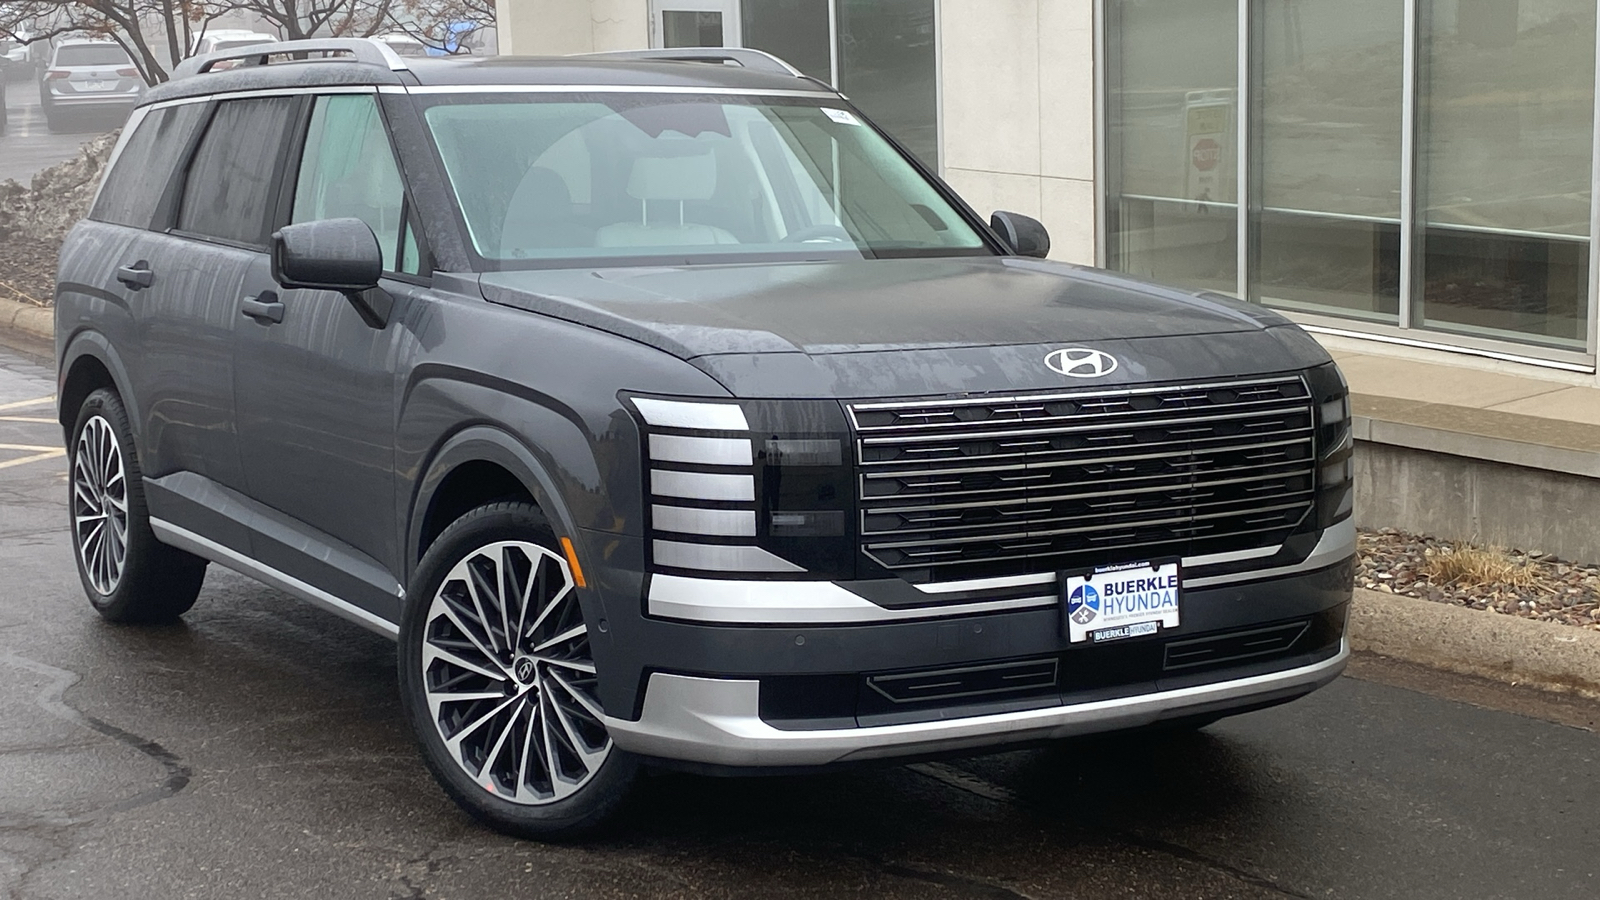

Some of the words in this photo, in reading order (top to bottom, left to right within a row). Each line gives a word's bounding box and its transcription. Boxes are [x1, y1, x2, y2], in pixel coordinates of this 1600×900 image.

[1095, 562, 1150, 573] buerklehyundai.com
[1104, 575, 1177, 596] BUERKLE
[1104, 590, 1178, 615] HYUNDAI
[1095, 628, 1129, 640] BUERKLE
[1130, 624, 1155, 635] HYUNDAI
